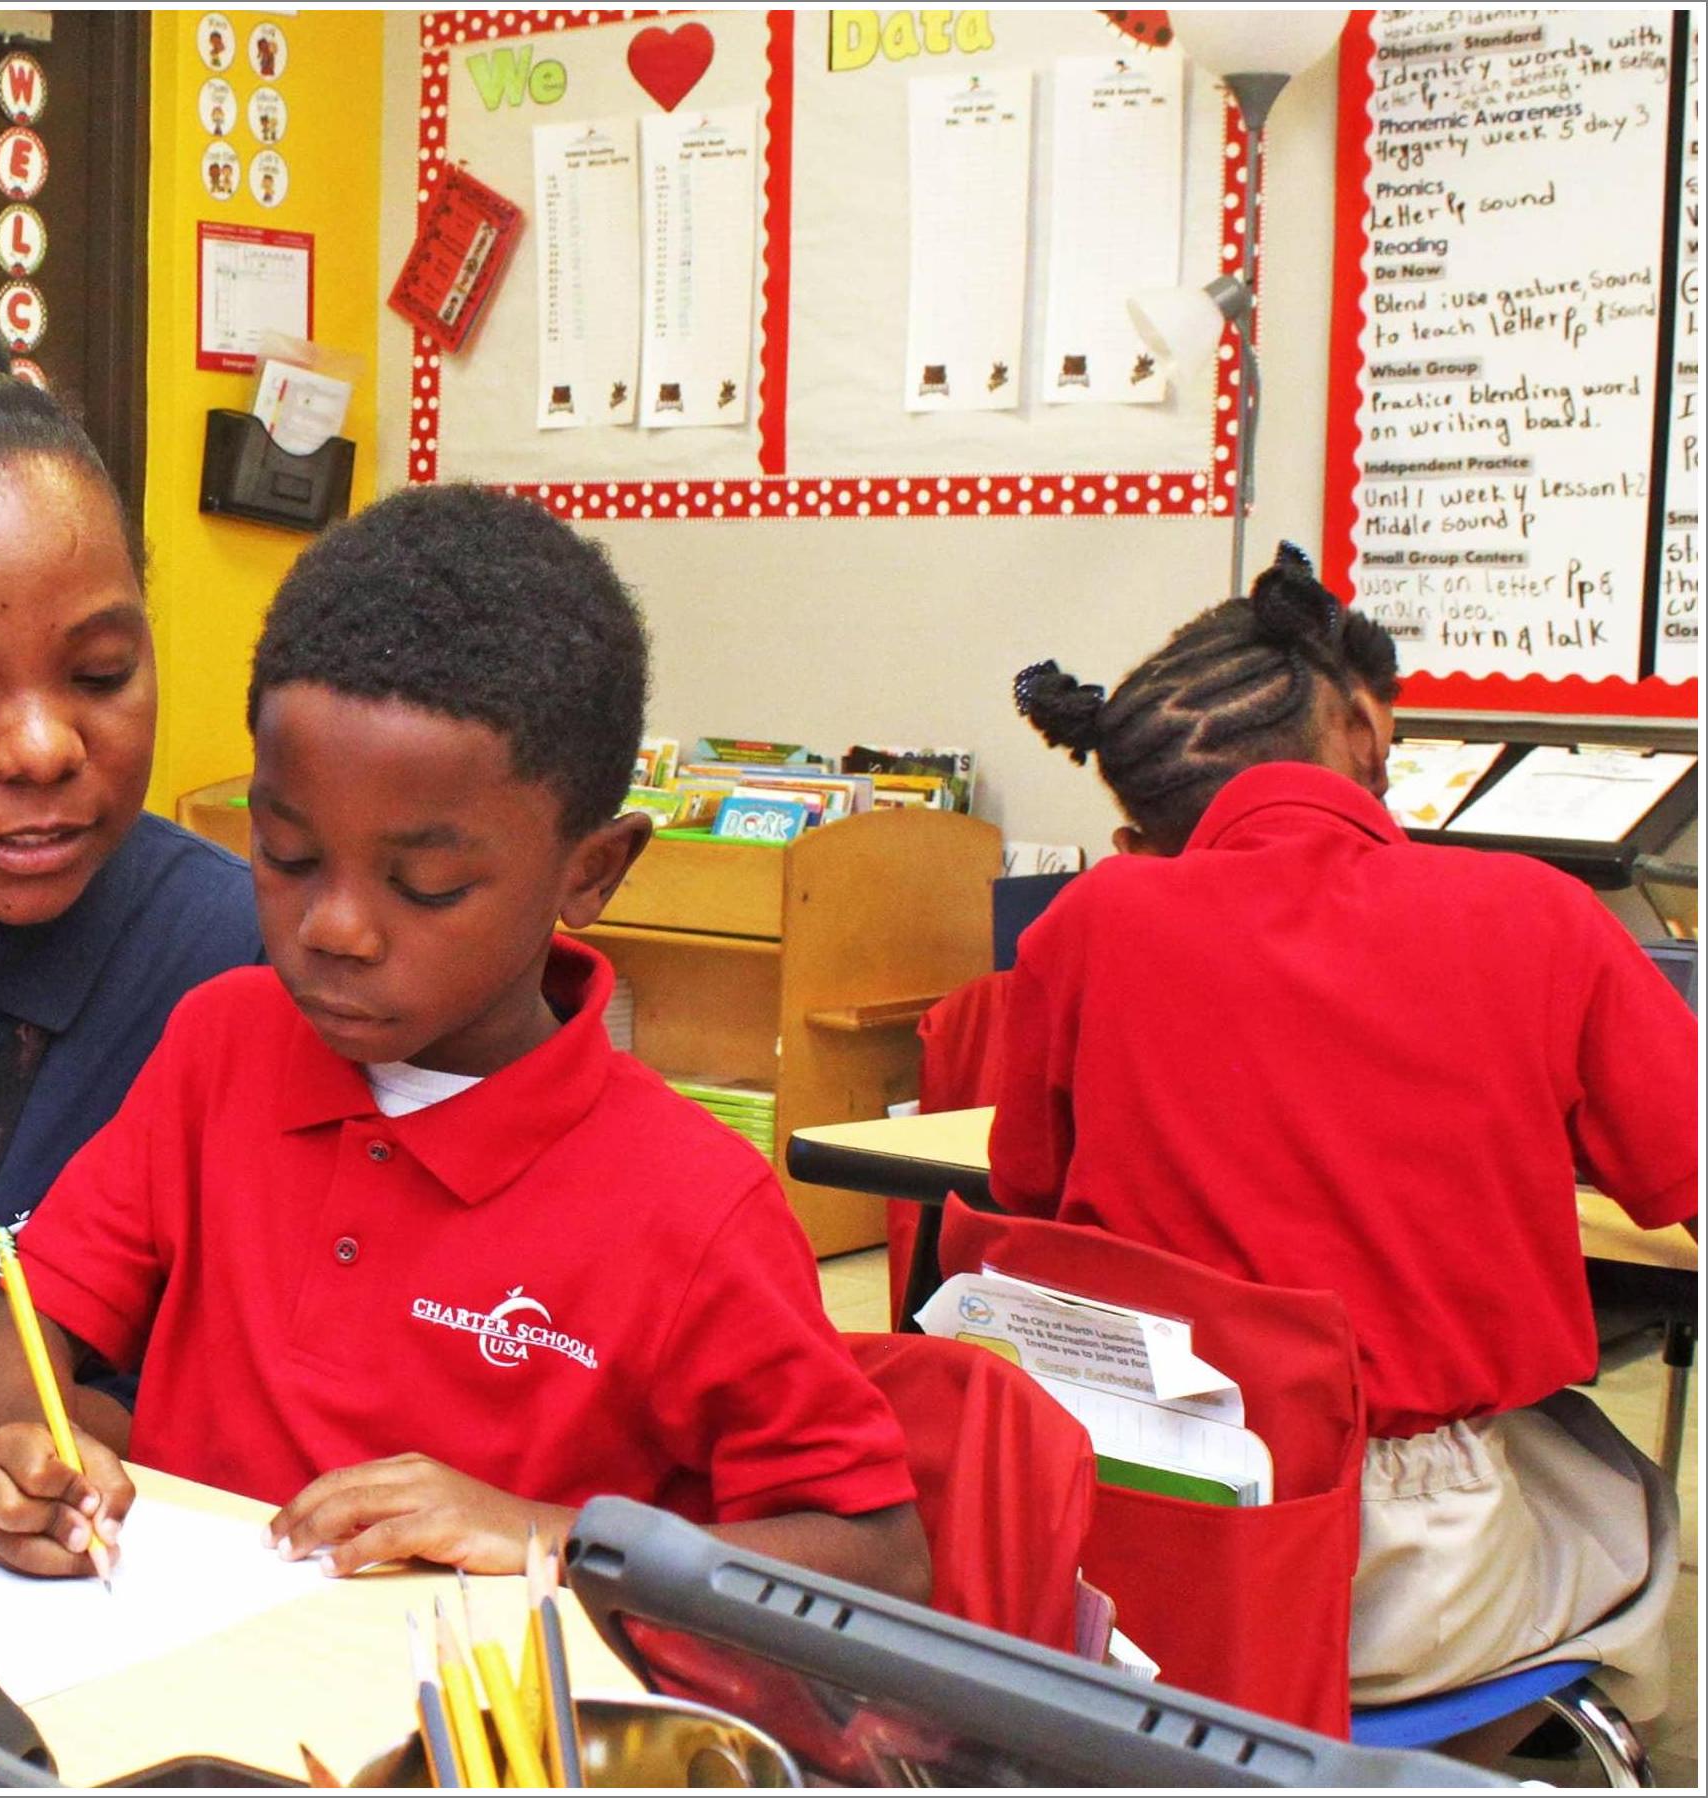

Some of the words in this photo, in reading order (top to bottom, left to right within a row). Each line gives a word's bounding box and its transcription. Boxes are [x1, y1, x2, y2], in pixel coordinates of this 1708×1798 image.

[831, 10, 994, 72] Data
[1378, 41, 1453, 61] Objective
[1464, 28, 1542, 51] Standard
[1377, 56, 1492, 92] Identify
[1508, 37, 1593, 68] words
[1609, 26, 1662, 51] with
[466, 44, 568, 112] We
[1378, 112, 1470, 135] Phonemic
[1474, 101, 1583, 127] Awareness
[1376, 133, 1469, 171] Heggerty
[1482, 123, 1548, 147] week
[1559, 118, 1576, 141] 5
[1583, 112, 1628, 143] day
[1376, 180, 1446, 200] Phonics
[1479, 180, 1557, 214] sound
[1374, 237, 1449, 258] Reading
[1374, 266, 1397, 281] Do
[1401, 264, 1443, 278] Now
[1374, 293, 1428, 315] Blend
[1375, 323, 1400, 349] to
[1412, 317, 1476, 340] teach
[1490, 307, 1557, 338] letter
[1370, 365, 1422, 379] Whole
[1426, 361, 1479, 378] Group
[1372, 391, 1454, 414] Practice
[1469, 374, 1576, 420] blending
[1582, 375, 1641, 397] word
[1370, 426, 1397, 442] on
[1410, 413, 1511, 447] writing
[1364, 460, 1463, 476] Independent
[1467, 457, 1530, 472] Practice
[1440, 483, 1506, 508] week
[1365, 515, 1432, 537] Middle
[1442, 508, 1509, 534] sound
[1362, 551, 1404, 565] Small
[1408, 551, 1460, 567] Group
[1465, 550, 1525, 565] Centers
[1442, 621, 1509, 648] turn
[412, 1297, 510, 1335] CHARTER
[515, 1322, 596, 1362] SCHOOLS
[1007, 1323, 1035, 1336] Parks
[1047, 1330, 1101, 1348] Recreation
[1010, 1313, 1030, 1324] The
[1030, 1316, 1050, 1330] City
[1052, 1321, 1064, 1331] of
[1065, 1324, 1093, 1337] North
[489, 1338, 529, 1360] USA
[1025, 1338, 1060, 1354] Invites
[1062, 1346, 1081, 1358] you
[1081, 1348, 1093, 1359] to
[1095, 1350, 1116, 1364] join
[1117, 1356, 1129, 1367] us
